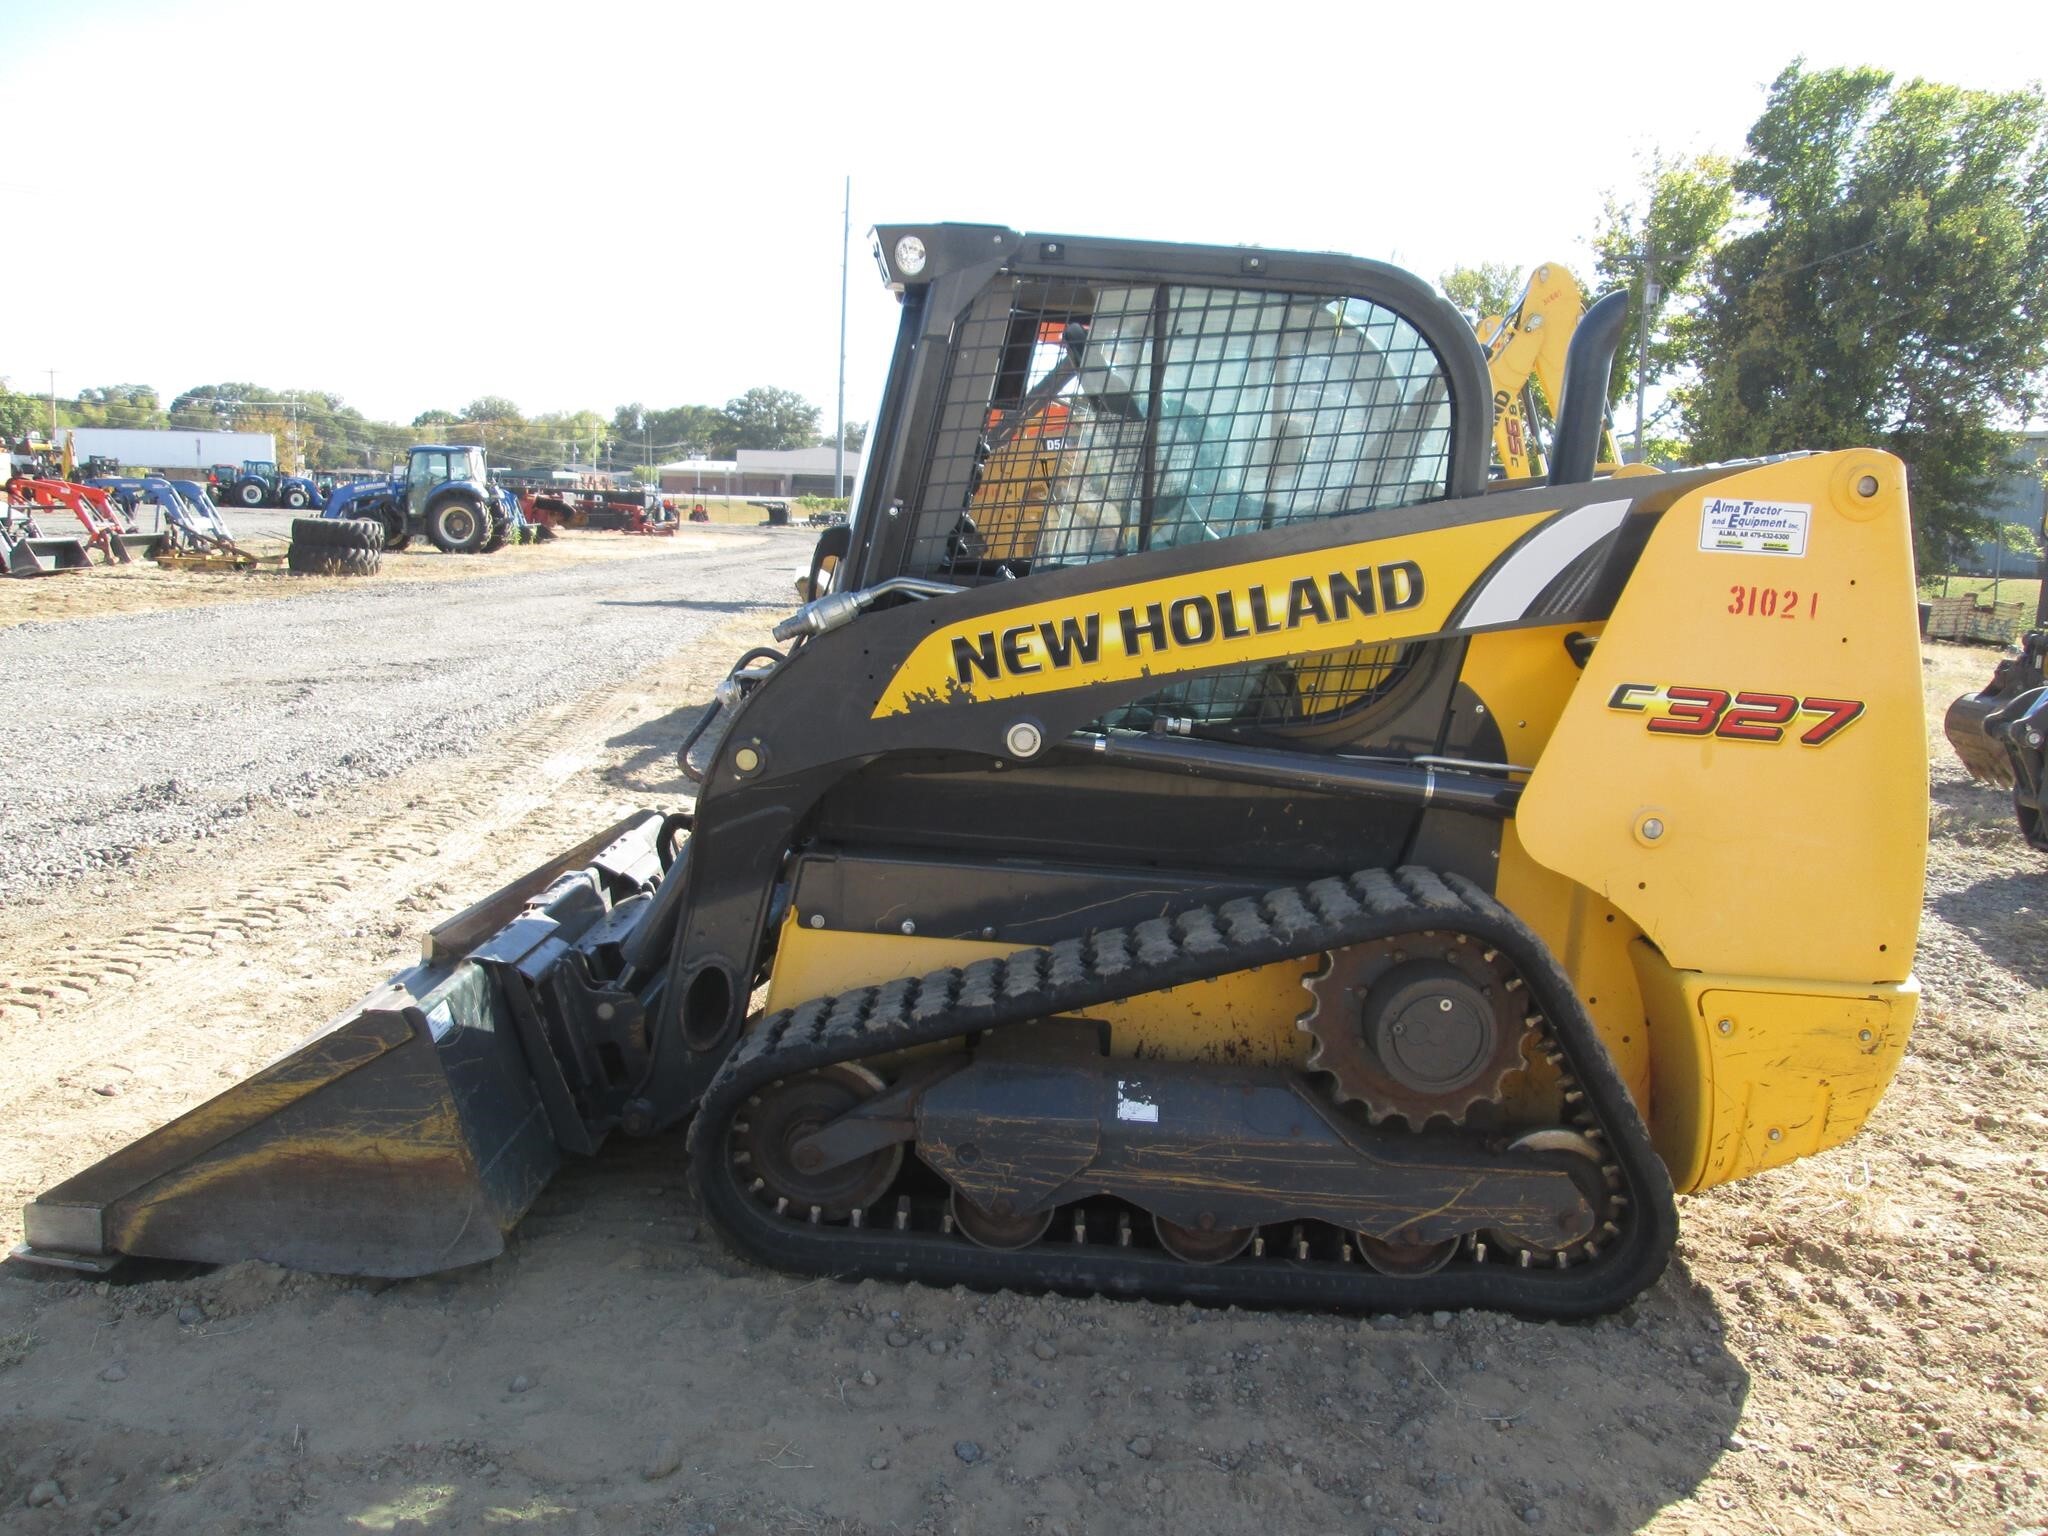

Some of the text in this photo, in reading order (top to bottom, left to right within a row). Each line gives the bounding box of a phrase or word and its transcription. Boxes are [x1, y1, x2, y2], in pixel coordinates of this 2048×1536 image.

[1711, 499, 1782, 515] Alma Tractor
[1728, 514, 1787, 528] Equipment
[950, 560, 1427, 685] NEW HOLLAND
